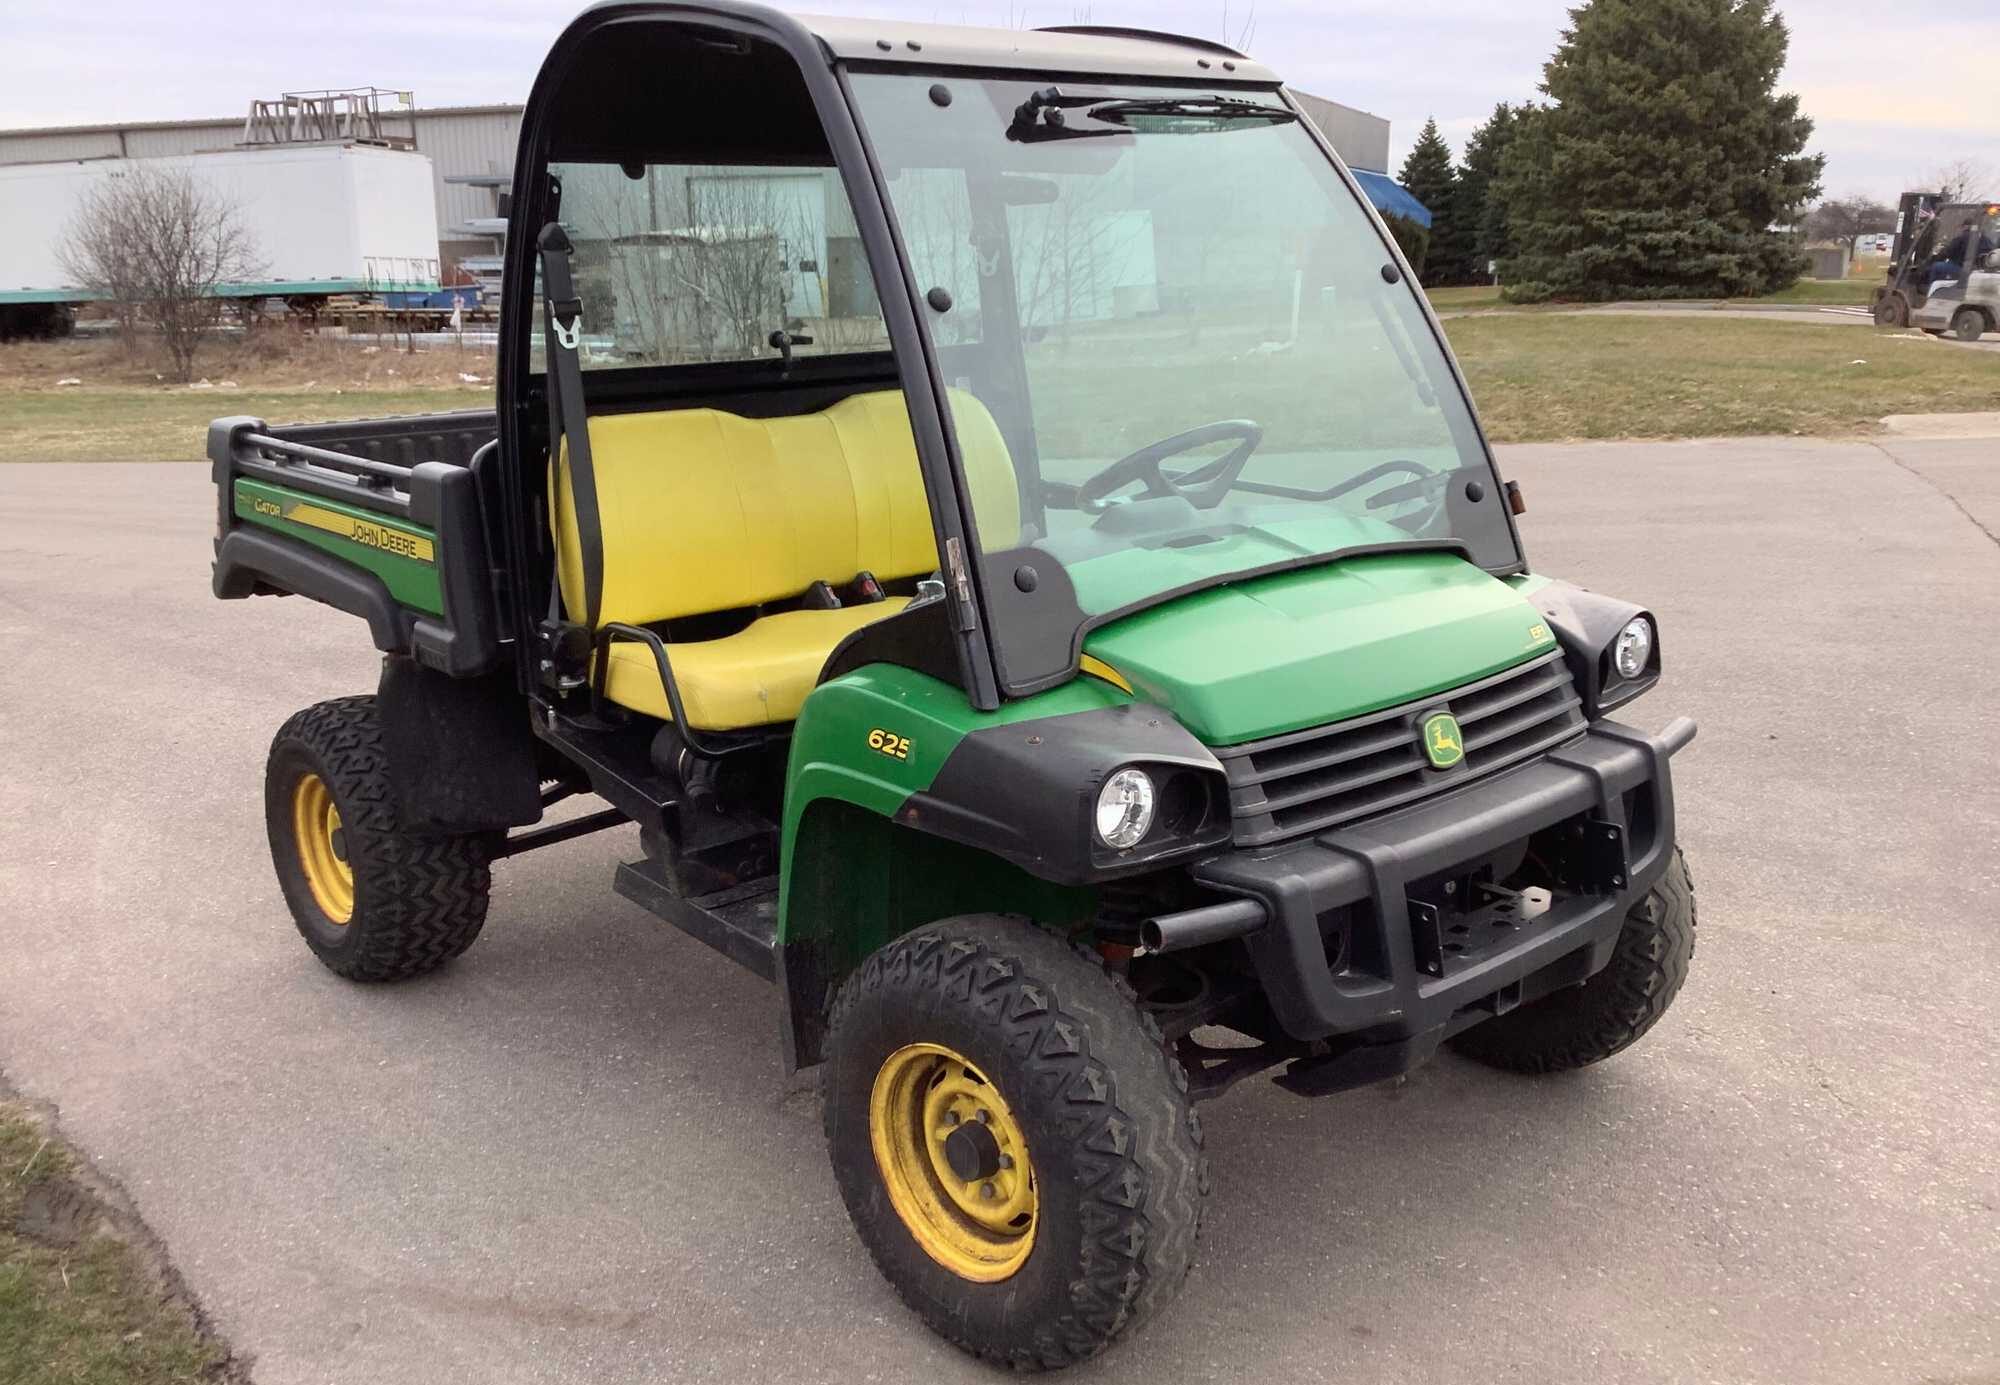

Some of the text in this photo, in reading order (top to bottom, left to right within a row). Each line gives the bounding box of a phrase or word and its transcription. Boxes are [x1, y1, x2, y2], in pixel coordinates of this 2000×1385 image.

[255, 498, 281, 517] GATOR
[351, 520, 417, 556] JOHN DEERE
[868, 728, 910, 760] 625
